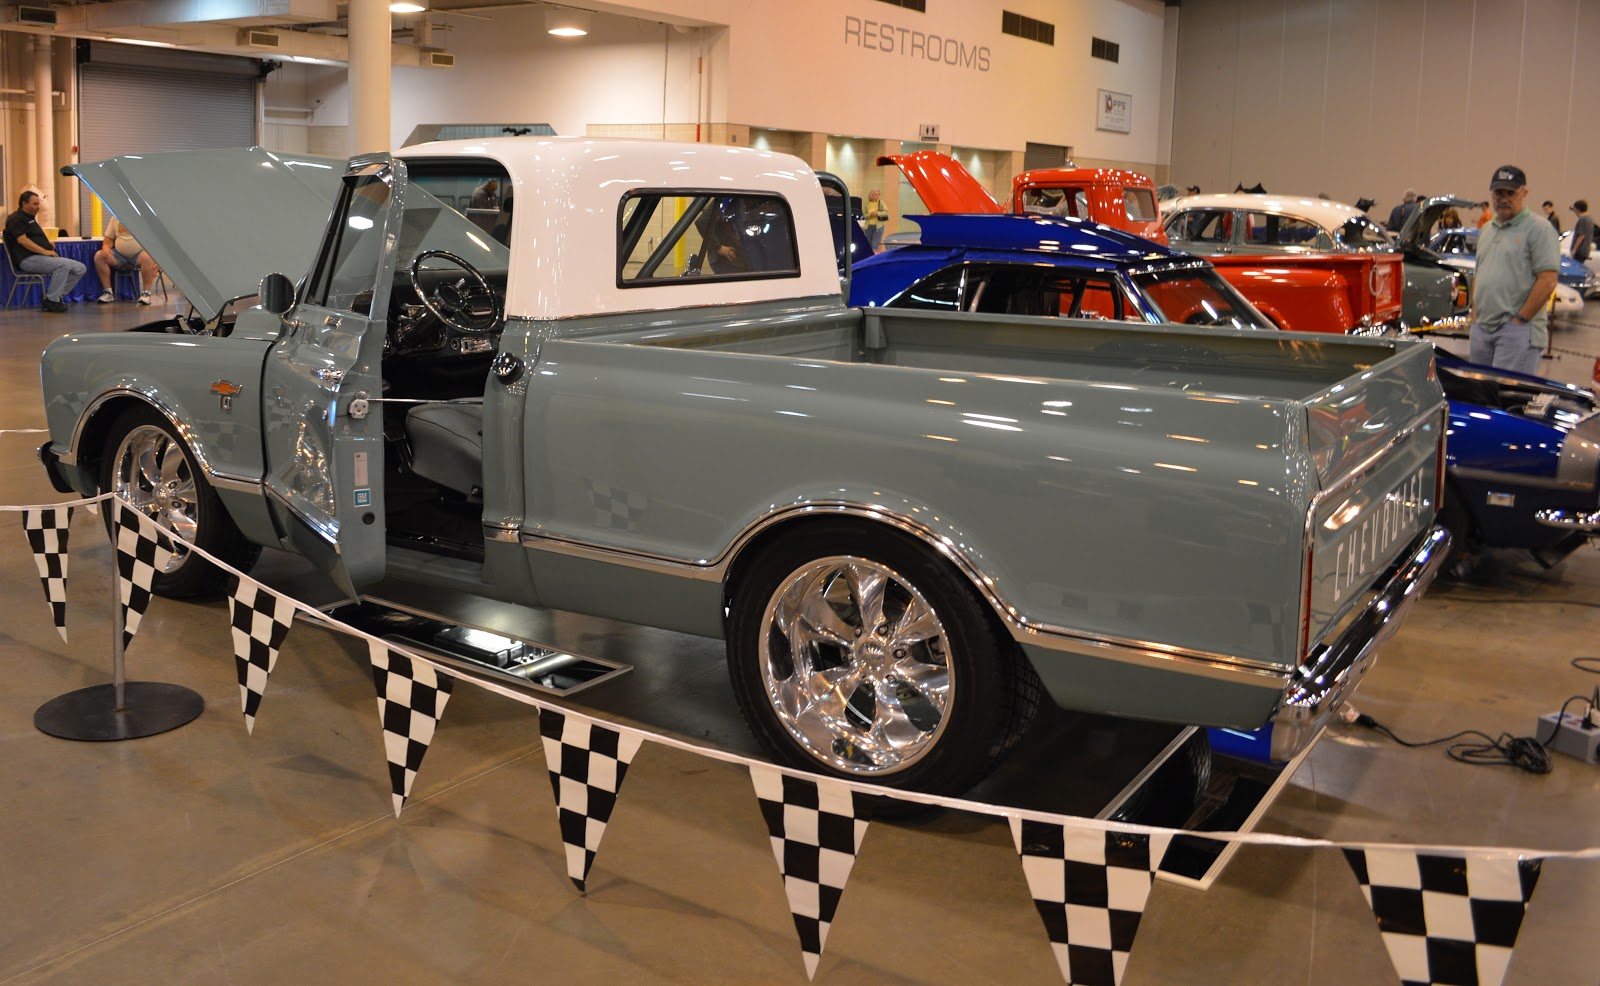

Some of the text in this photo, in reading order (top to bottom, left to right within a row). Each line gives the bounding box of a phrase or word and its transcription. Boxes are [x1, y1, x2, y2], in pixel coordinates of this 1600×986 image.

[844, 15, 991, 72] RESTROOMS
[1113, 99, 1126, 111] PPS
[1334, 466, 1424, 602] CHEVROLET
